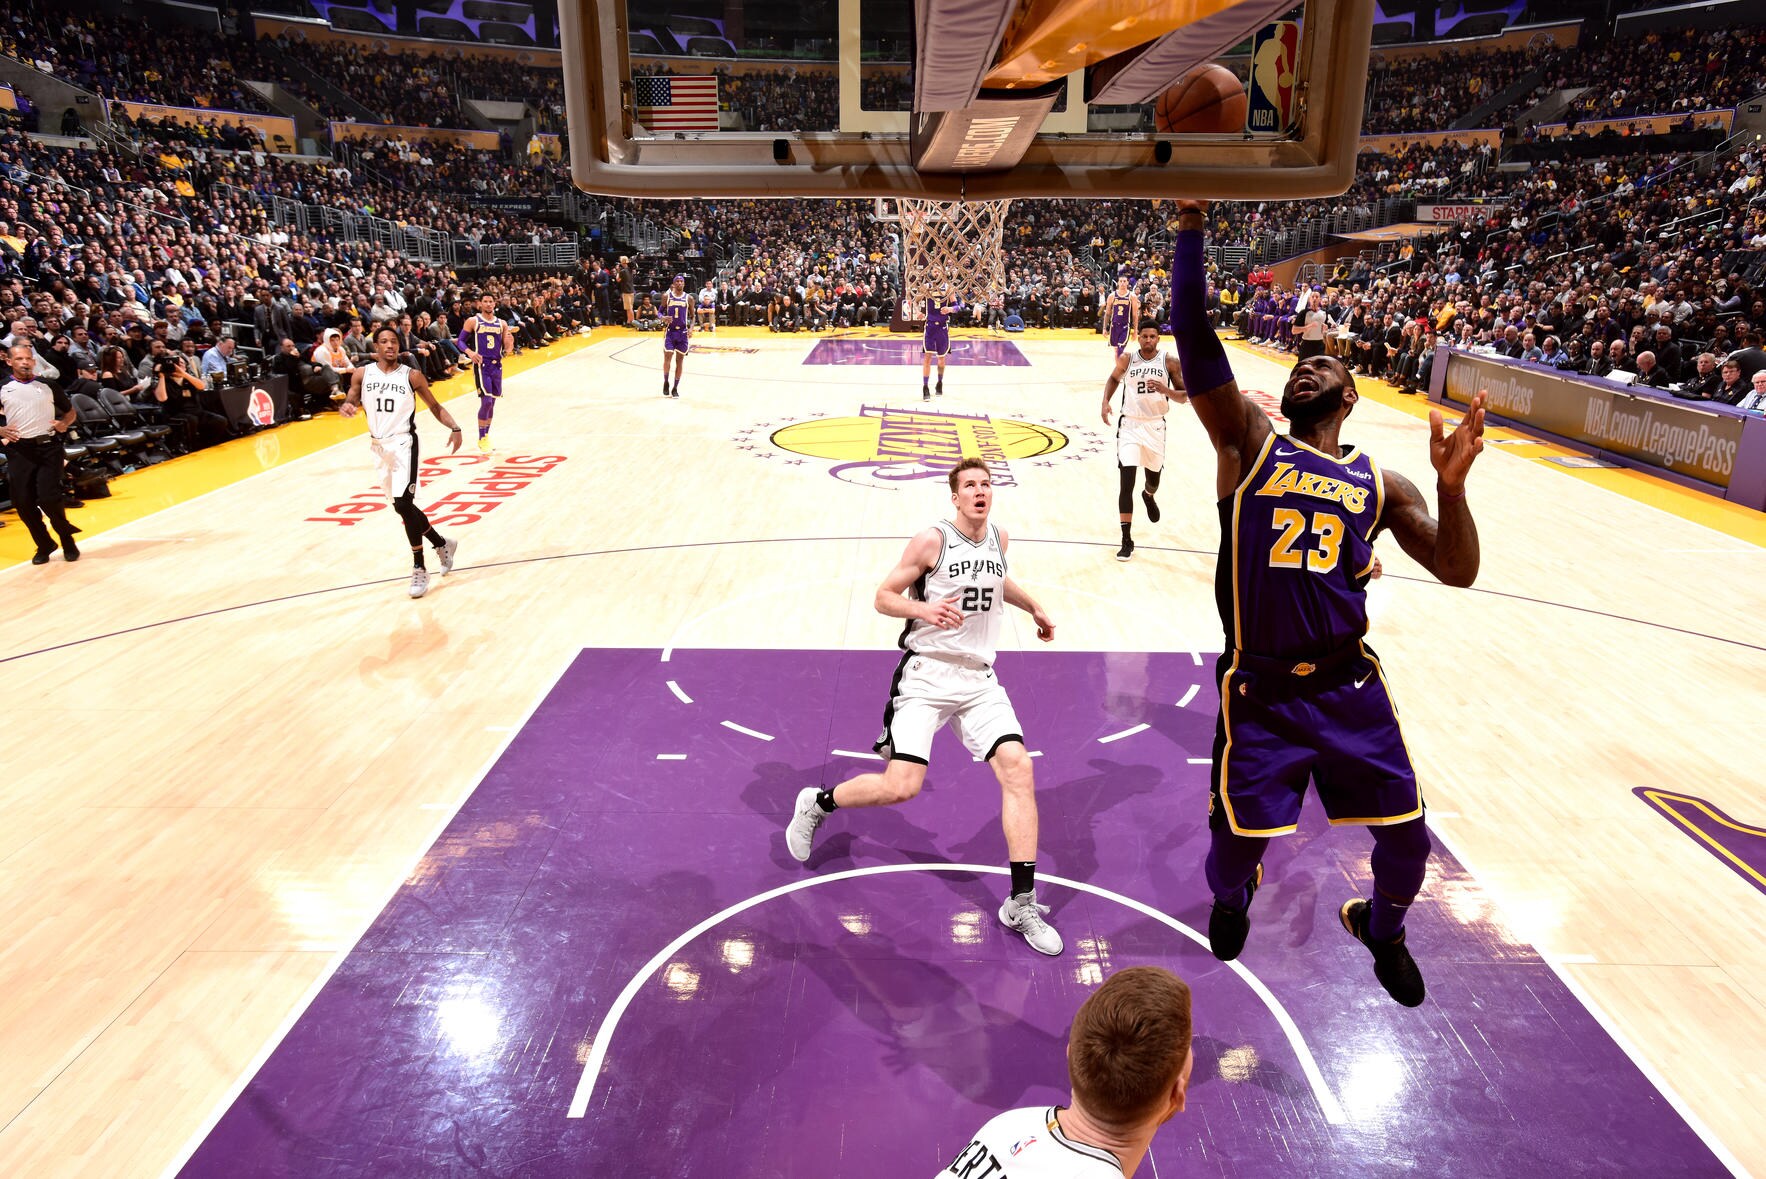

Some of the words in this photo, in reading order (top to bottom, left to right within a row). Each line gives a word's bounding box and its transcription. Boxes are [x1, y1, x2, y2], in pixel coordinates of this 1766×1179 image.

[1252, 109, 1274, 127] NBA
[1118, 306, 1124, 316] 2
[486, 334, 495, 349] 3
[1130, 367, 1163, 378] SPURS
[366, 382, 406, 395] SPURS
[1506, 377, 1534, 415] Pass
[376, 398, 395, 413] 10
[1583, 397, 1737, 476] NBA.com/LeaguePass
[1345, 466, 1372, 480] wish
[304, 455, 490, 526] Ceter
[1255, 461, 1369, 514] LAKERS
[1268, 507, 1345, 574] 23
[949, 559, 1003, 581] SPURS
[962, 587, 994, 611] 25
